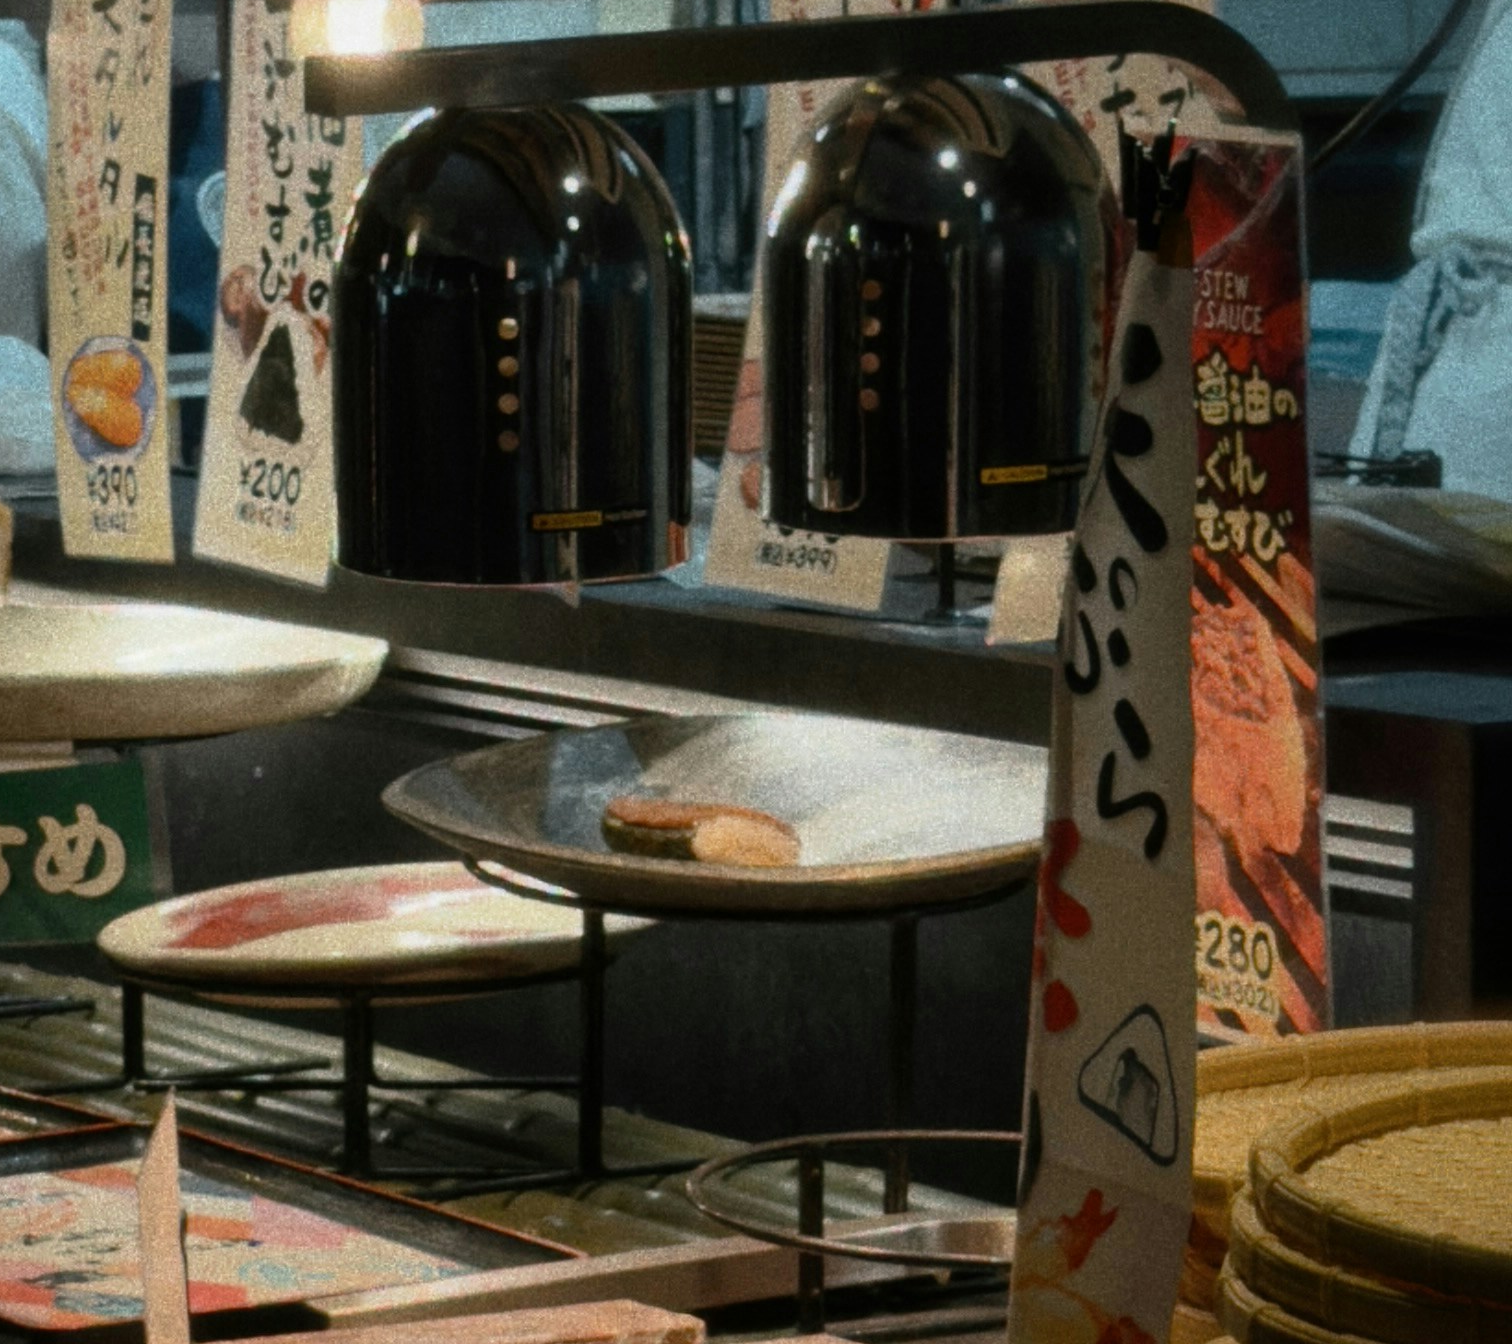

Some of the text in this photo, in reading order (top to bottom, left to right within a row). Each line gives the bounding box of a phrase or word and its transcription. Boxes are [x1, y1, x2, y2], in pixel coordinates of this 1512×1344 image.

[1200, 268, 1250, 302] STEW
[1204, 303, 1265, 336] SAUCE
[87, 464, 137, 507] ¥390
[240, 457, 301, 508] ¥200
[1194, 430, 1268, 498] ぐれ
